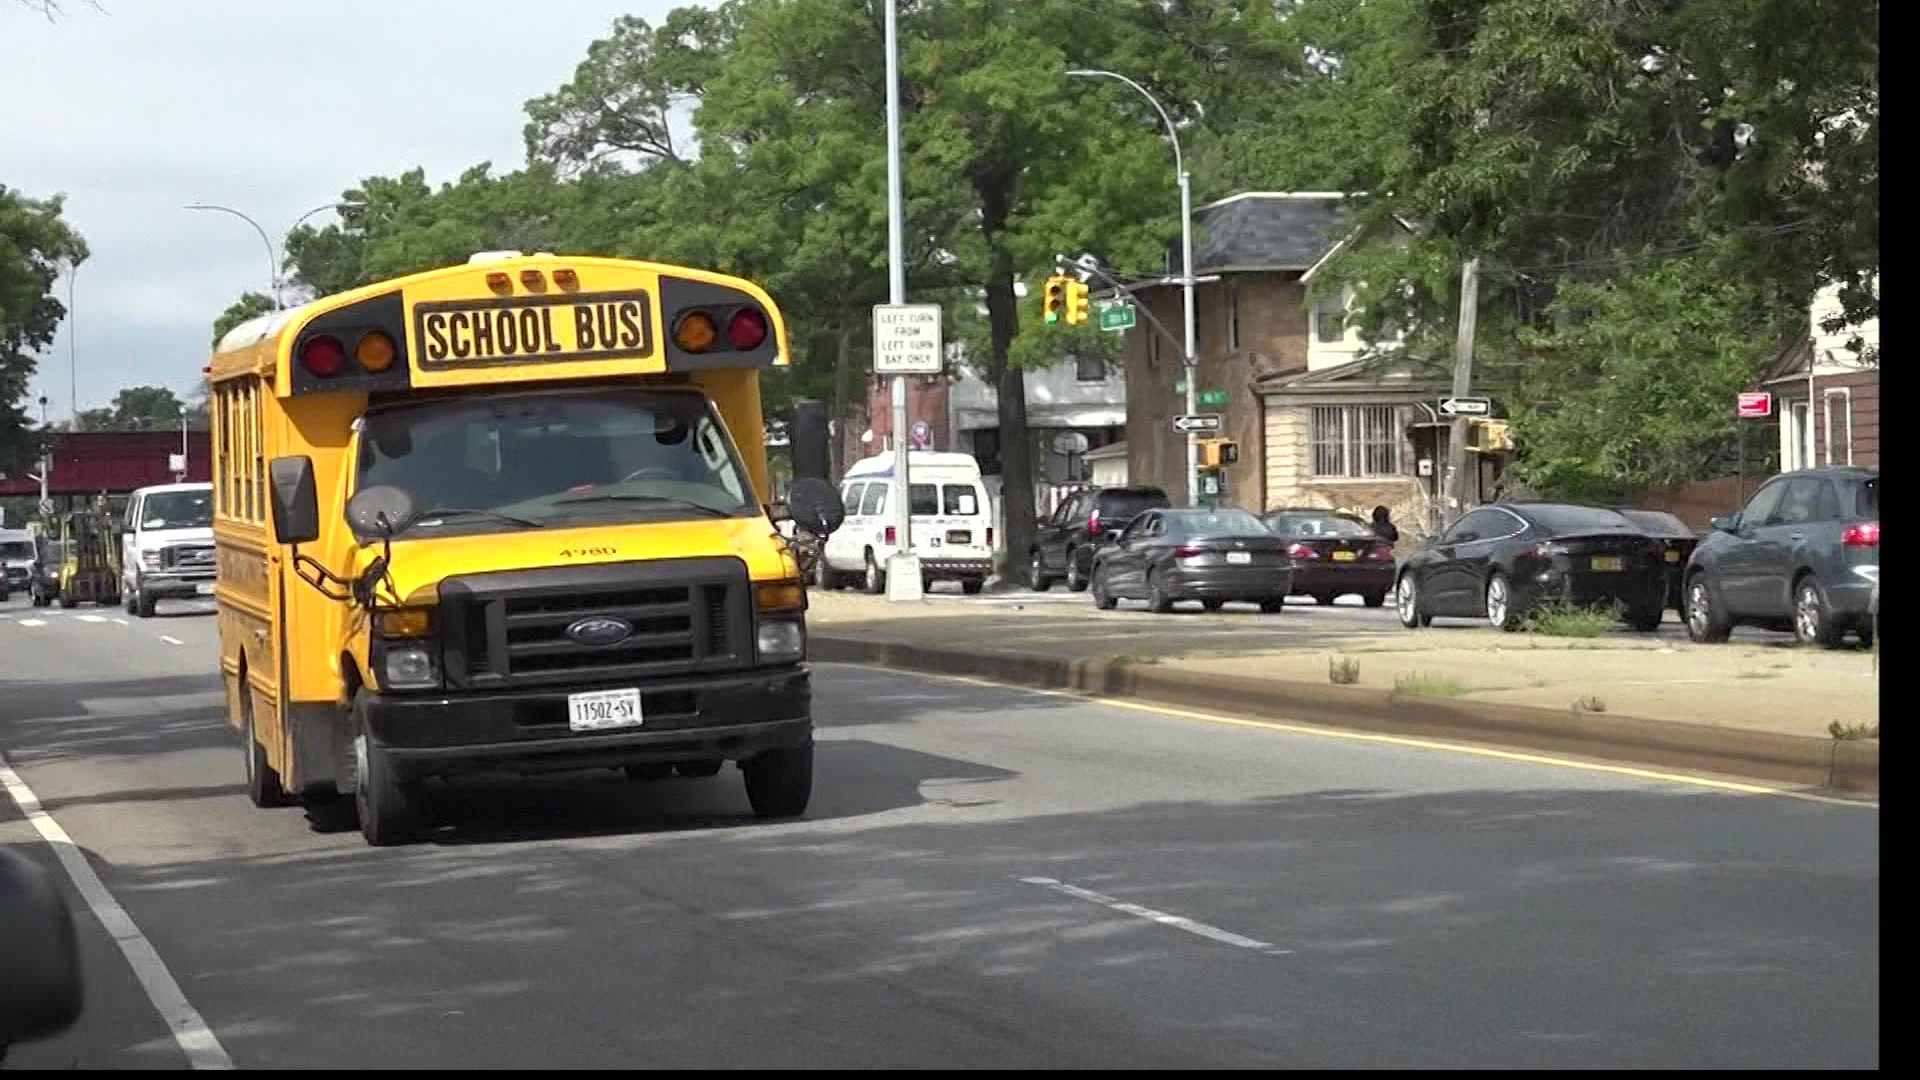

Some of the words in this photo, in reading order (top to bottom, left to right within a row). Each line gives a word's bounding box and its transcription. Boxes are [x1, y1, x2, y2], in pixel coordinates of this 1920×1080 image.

[881, 314, 904, 324] LEFT
[427, 308, 562, 360] SCHOOL
[574, 302, 641, 350] BUS
[895, 327, 920, 336] FROM
[881, 340, 904, 351] LEFT
[885, 354, 902, 365] BAY
[907, 353, 931, 364] ONLY
